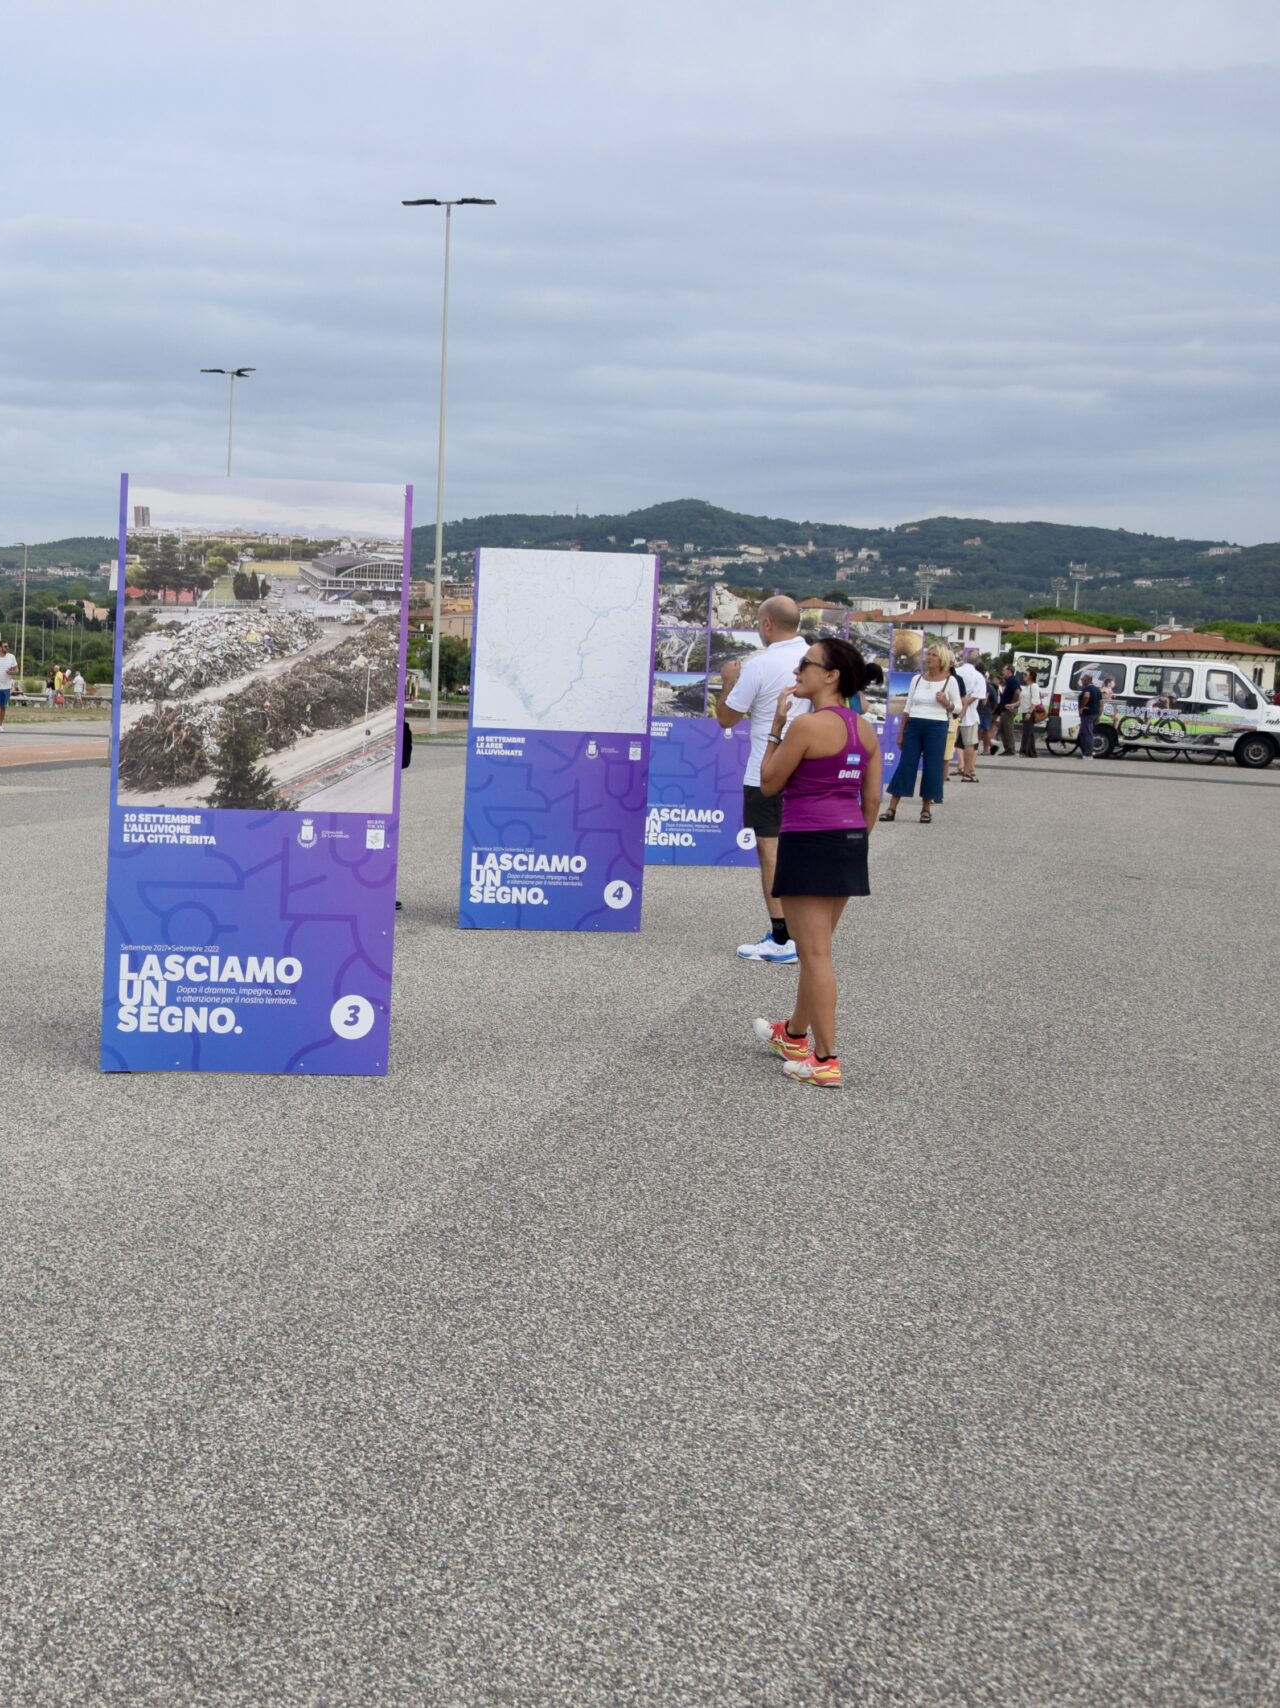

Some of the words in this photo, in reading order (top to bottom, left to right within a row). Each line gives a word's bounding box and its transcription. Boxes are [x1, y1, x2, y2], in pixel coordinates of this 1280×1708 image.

[485, 736, 526, 744] SETTEMBRE
[123, 813, 137, 822] 10
[138, 814, 202, 824] SETTEMBRE
[648, 807, 725, 823] ASCIAMO
[123, 823, 191, 834] L'ALLUVIONE
[123, 833, 130, 842] E
[131, 833, 146, 843] LA
[147, 832, 178, 844] CITTÀ
[179, 835, 217, 845] FERITA
[743, 833, 751, 843] 5
[471, 852, 587, 873] LASCIAMO
[470, 869, 501, 887] UN
[469, 886, 549, 905] SEGNO.
[613, 887, 625, 900] 4
[120, 943, 152, 951] Settembre
[120, 953, 303, 984] LASCIAMO
[119, 979, 167, 1006] UN
[176, 985, 198, 995] Dopo
[205, 987, 238, 995] dramma,
[239, 988, 273, 997] impegno,
[221, 996, 234, 1005] per
[116, 1005, 243, 1034] SEGNO.
[343, 1004, 360, 1027] 3
